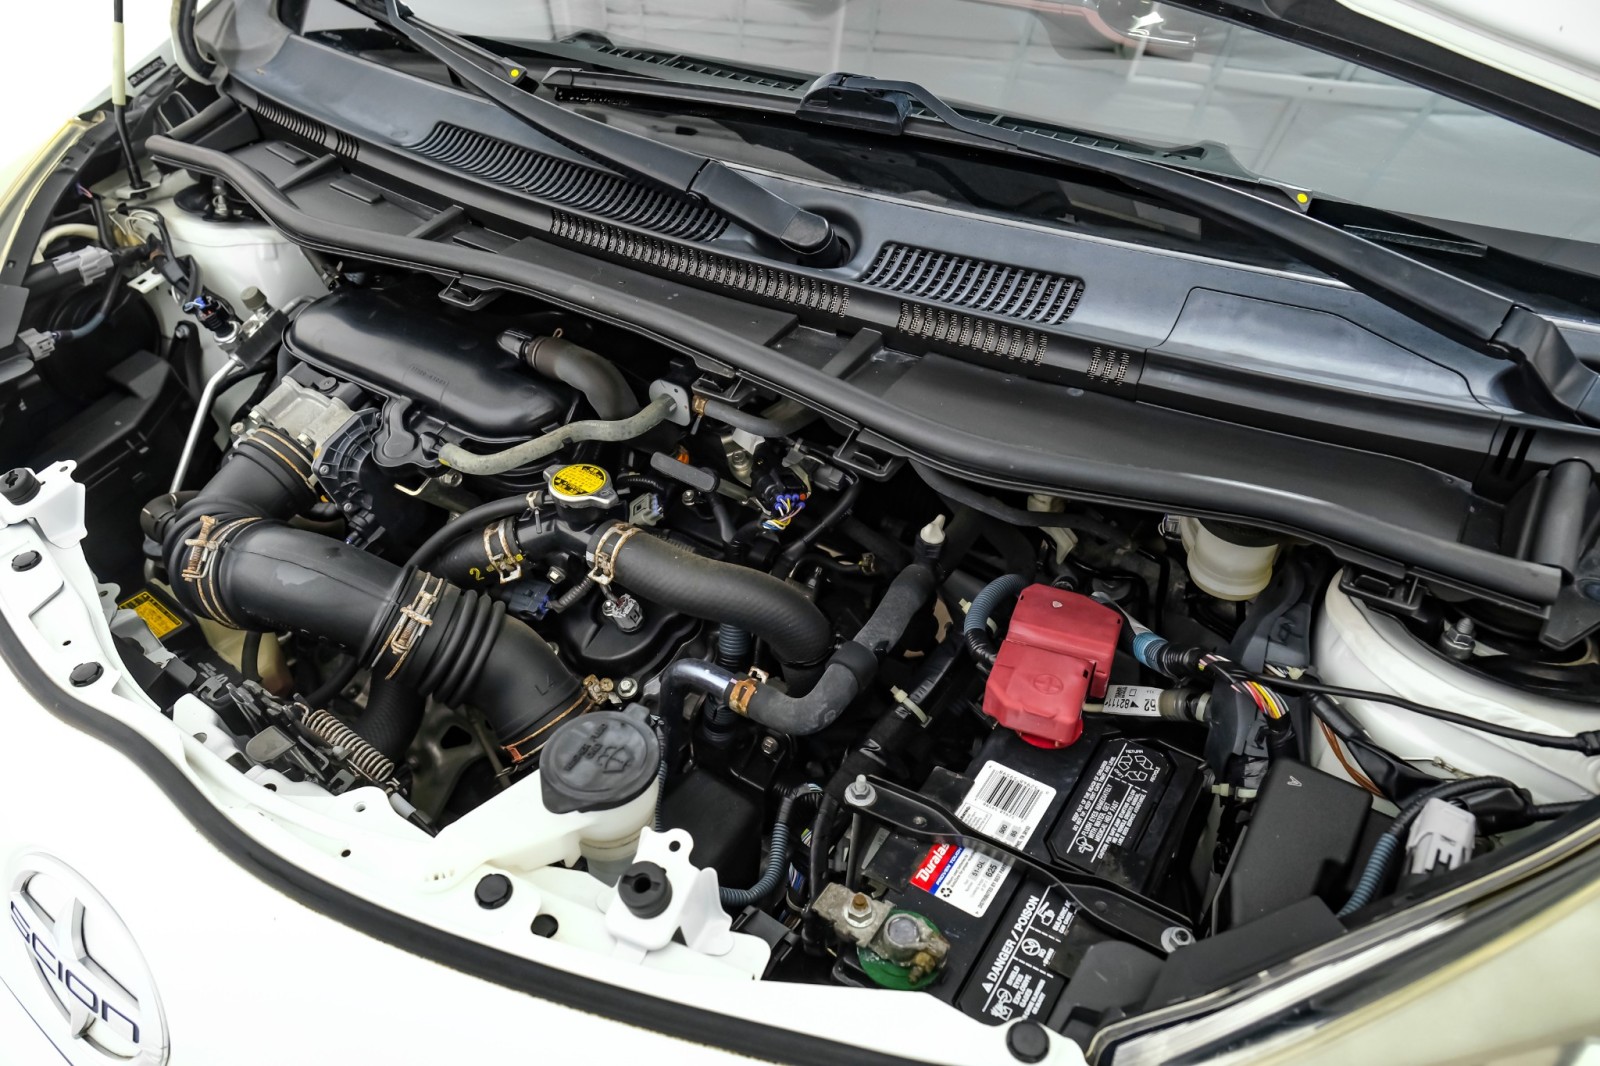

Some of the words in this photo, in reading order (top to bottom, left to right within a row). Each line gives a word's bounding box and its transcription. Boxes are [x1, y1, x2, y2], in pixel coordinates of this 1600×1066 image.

[1081, 821, 1094, 837] FLUSH
[1088, 810, 1099, 823] EYES
[1094, 783, 1114, 811] IMMEDIATELY
[1109, 800, 1120, 812] FAST
[1087, 826, 1099, 840] WITH
[1102, 802, 1111, 812] GET
[1104, 811, 1115, 824] HELP
[1094, 822, 1109, 843] MEDICAL
[915, 838, 951, 885] Duralas
[972, 859, 986, 877] 51-DL
[985, 863, 998, 878] 625
[935, 863, 952, 886] PROVEN
[986, 938, 1017, 983] DANGER
[1013, 894, 1041, 933] POISON
[1038, 948, 1048, 959] NO
[1005, 965, 1021, 987] SHIELD
[1012, 973, 1025, 989] EYES
[1011, 973, 1034, 1005] EXPLOSIVE
[1018, 987, 1034, 1009] GASES
